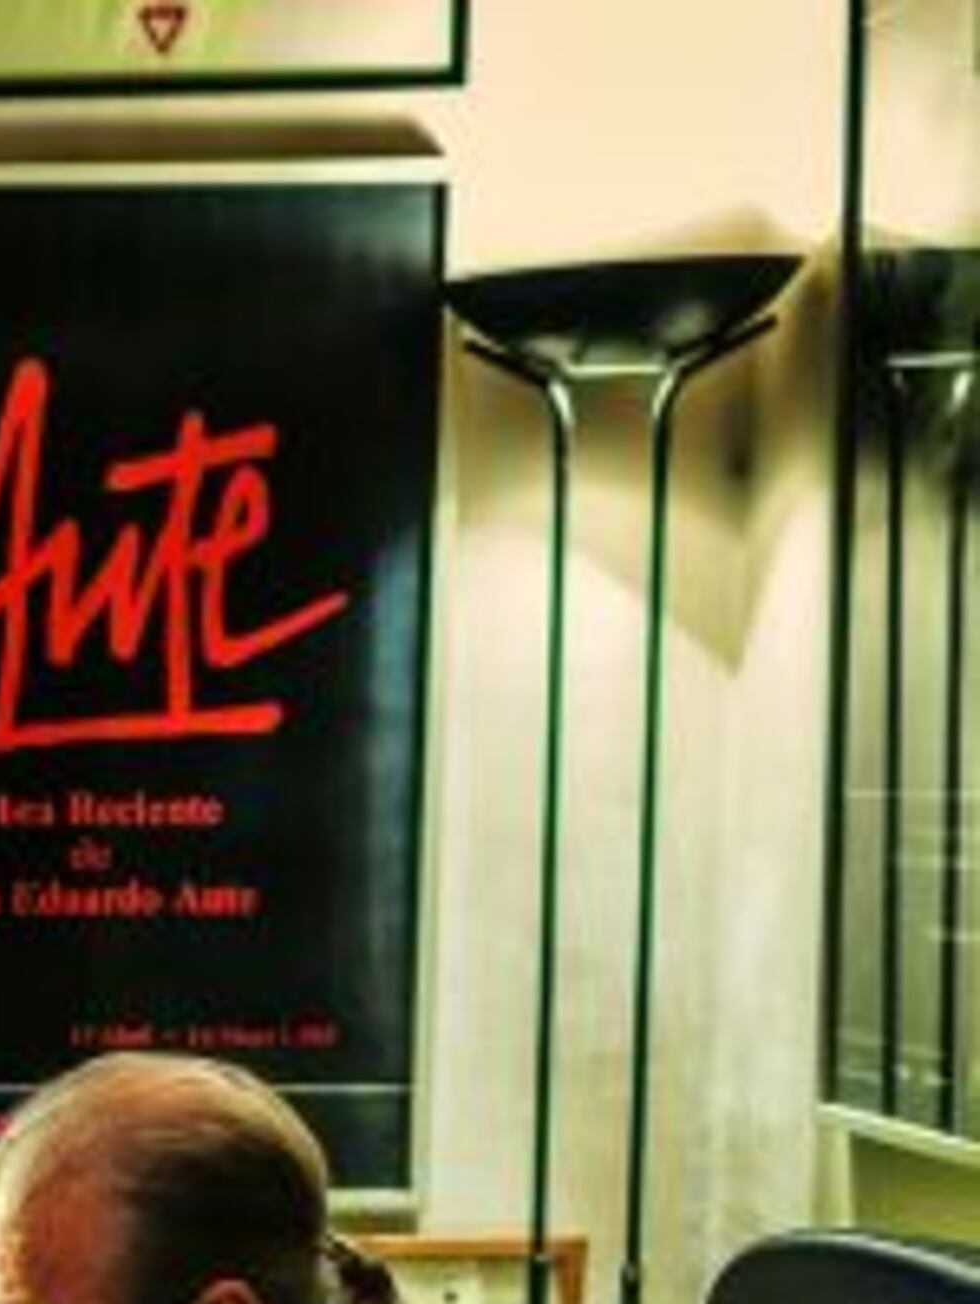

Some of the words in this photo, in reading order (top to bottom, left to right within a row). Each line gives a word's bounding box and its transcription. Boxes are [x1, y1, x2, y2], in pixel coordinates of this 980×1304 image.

[68, 793, 224, 827] Reciente
[72, 838, 111, 870] de
[13, 879, 163, 917] Eduardo
[176, 880, 262, 917] Aute
